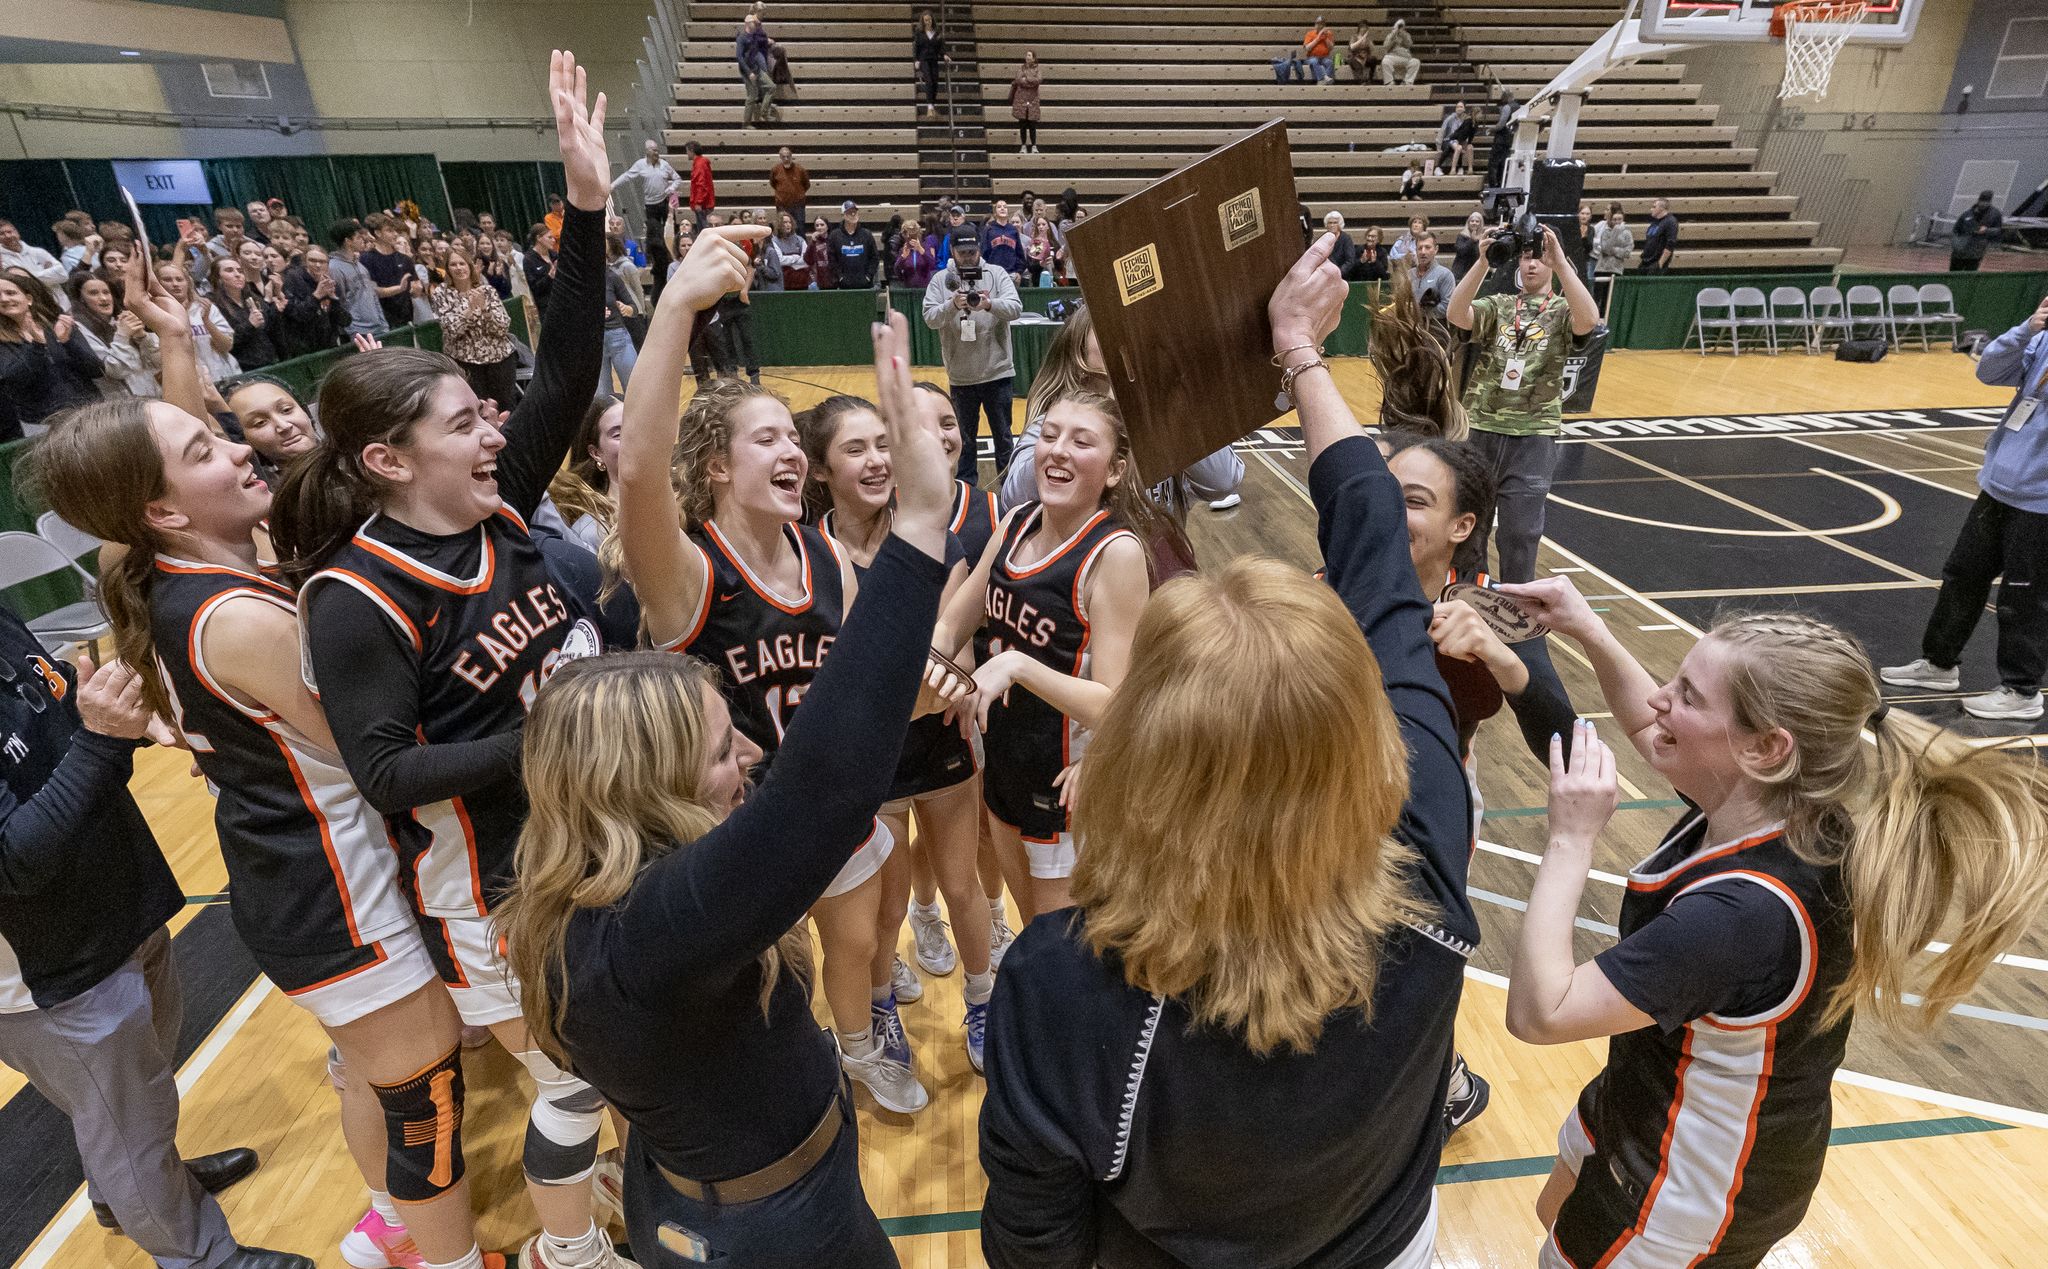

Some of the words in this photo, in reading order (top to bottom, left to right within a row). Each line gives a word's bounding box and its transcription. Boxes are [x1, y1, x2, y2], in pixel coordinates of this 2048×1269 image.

[958, 129, 965, 138] G
[960, 153, 967, 162] F
[145, 174, 175, 190] EXIT
[964, 203, 971, 213] D
[1227, 196, 1253, 218] ETCHED
[1230, 209, 1254, 230] VALOR
[1123, 252, 1149, 274] ETCHED
[1126, 264, 1151, 285] VALOR
[1560, 410, 1942, 437] MMUNITY
[984, 583, 1057, 649] AGLES
[451, 582, 568, 694] EAGLES
[724, 632, 837, 685] EAGLE
